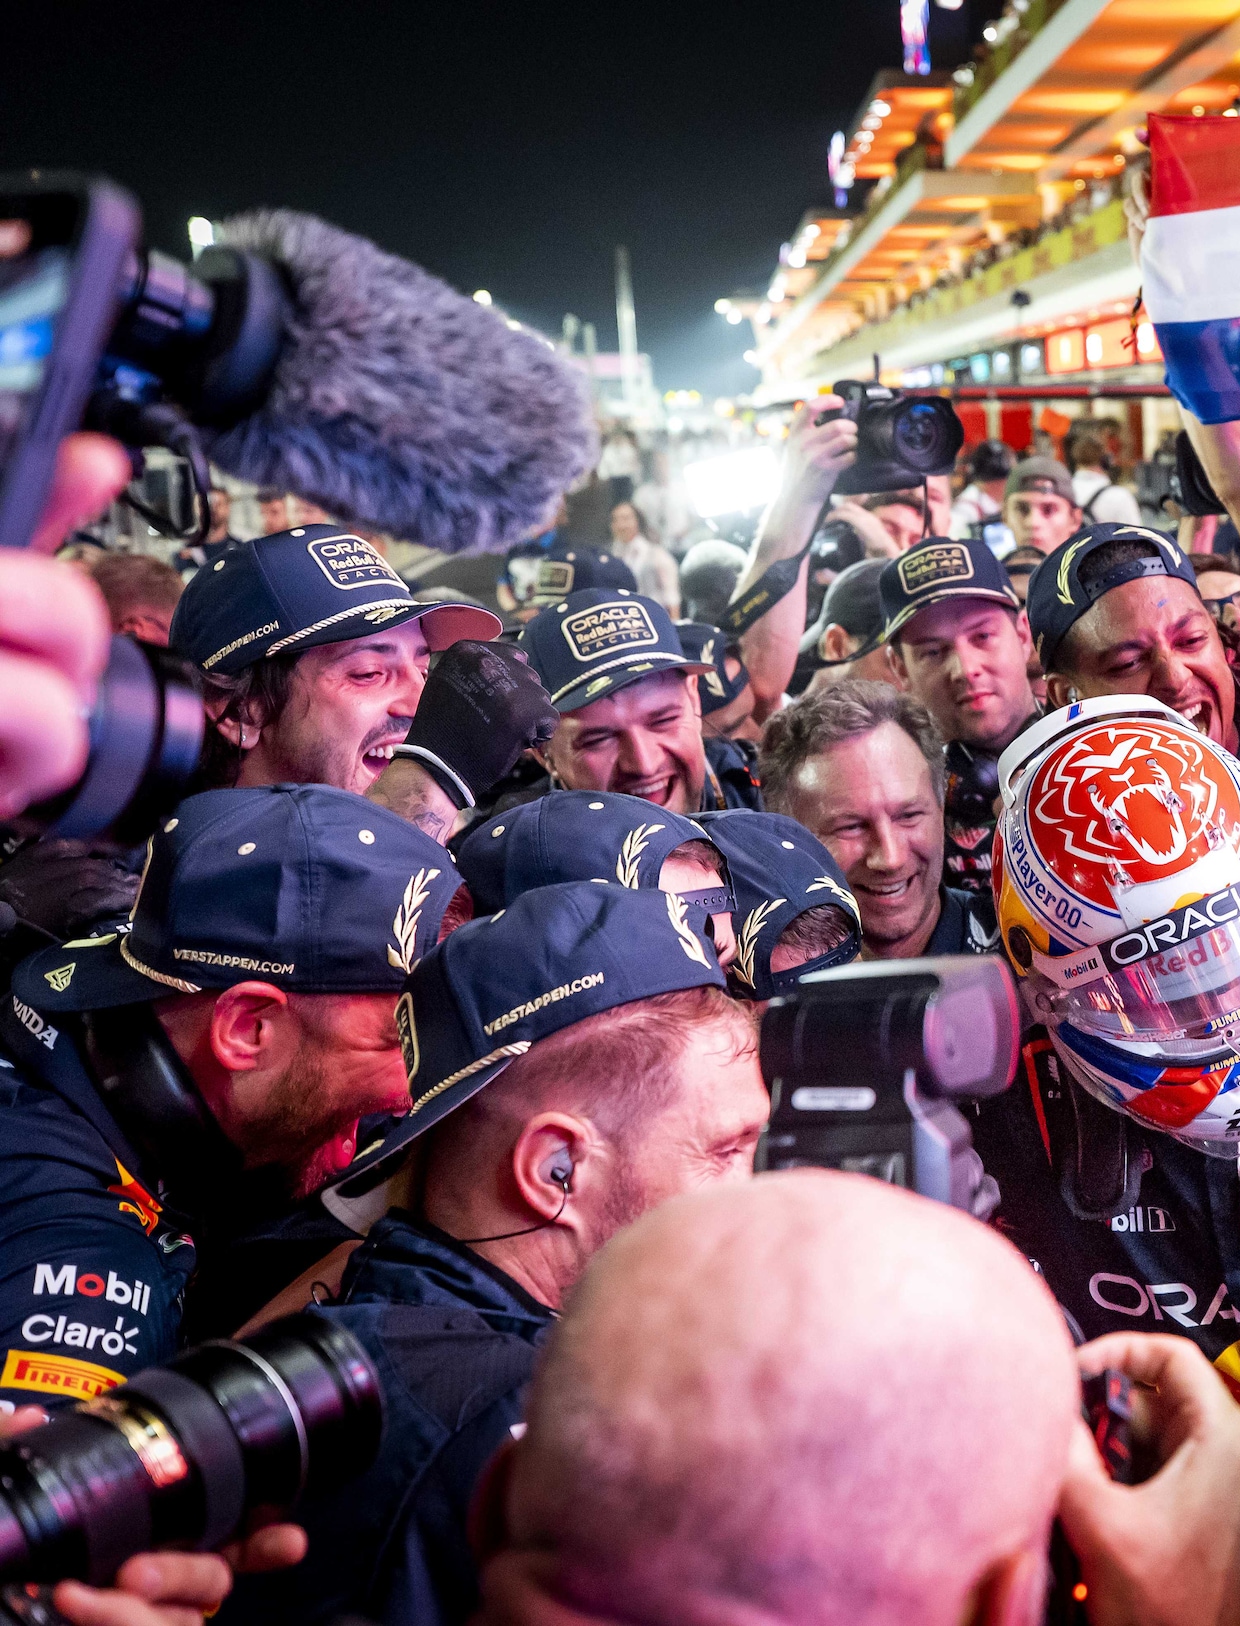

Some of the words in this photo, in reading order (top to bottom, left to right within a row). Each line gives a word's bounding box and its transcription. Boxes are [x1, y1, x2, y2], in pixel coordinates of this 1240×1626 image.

[337, 568, 396, 582] RACIN
[571, 607, 641, 632] ORACLE
[575, 628, 597, 645] Red
[596, 621, 618, 637] Bull
[581, 631, 652, 654] RACING
[1012, 839, 1056, 908] Player
[1055, 897, 1083, 929] 0.0
[173, 948, 294, 975] VERSTAPPEN.COM
[1064, 960, 1088, 980] Mobil
[1146, 936, 1209, 979] Red
[483, 972, 605, 1037] VERSTAPPEN.COM
[1111, 1206, 1144, 1232] bil
[33, 1263, 151, 1316] Mobil
[22, 1314, 126, 1356] Claro
